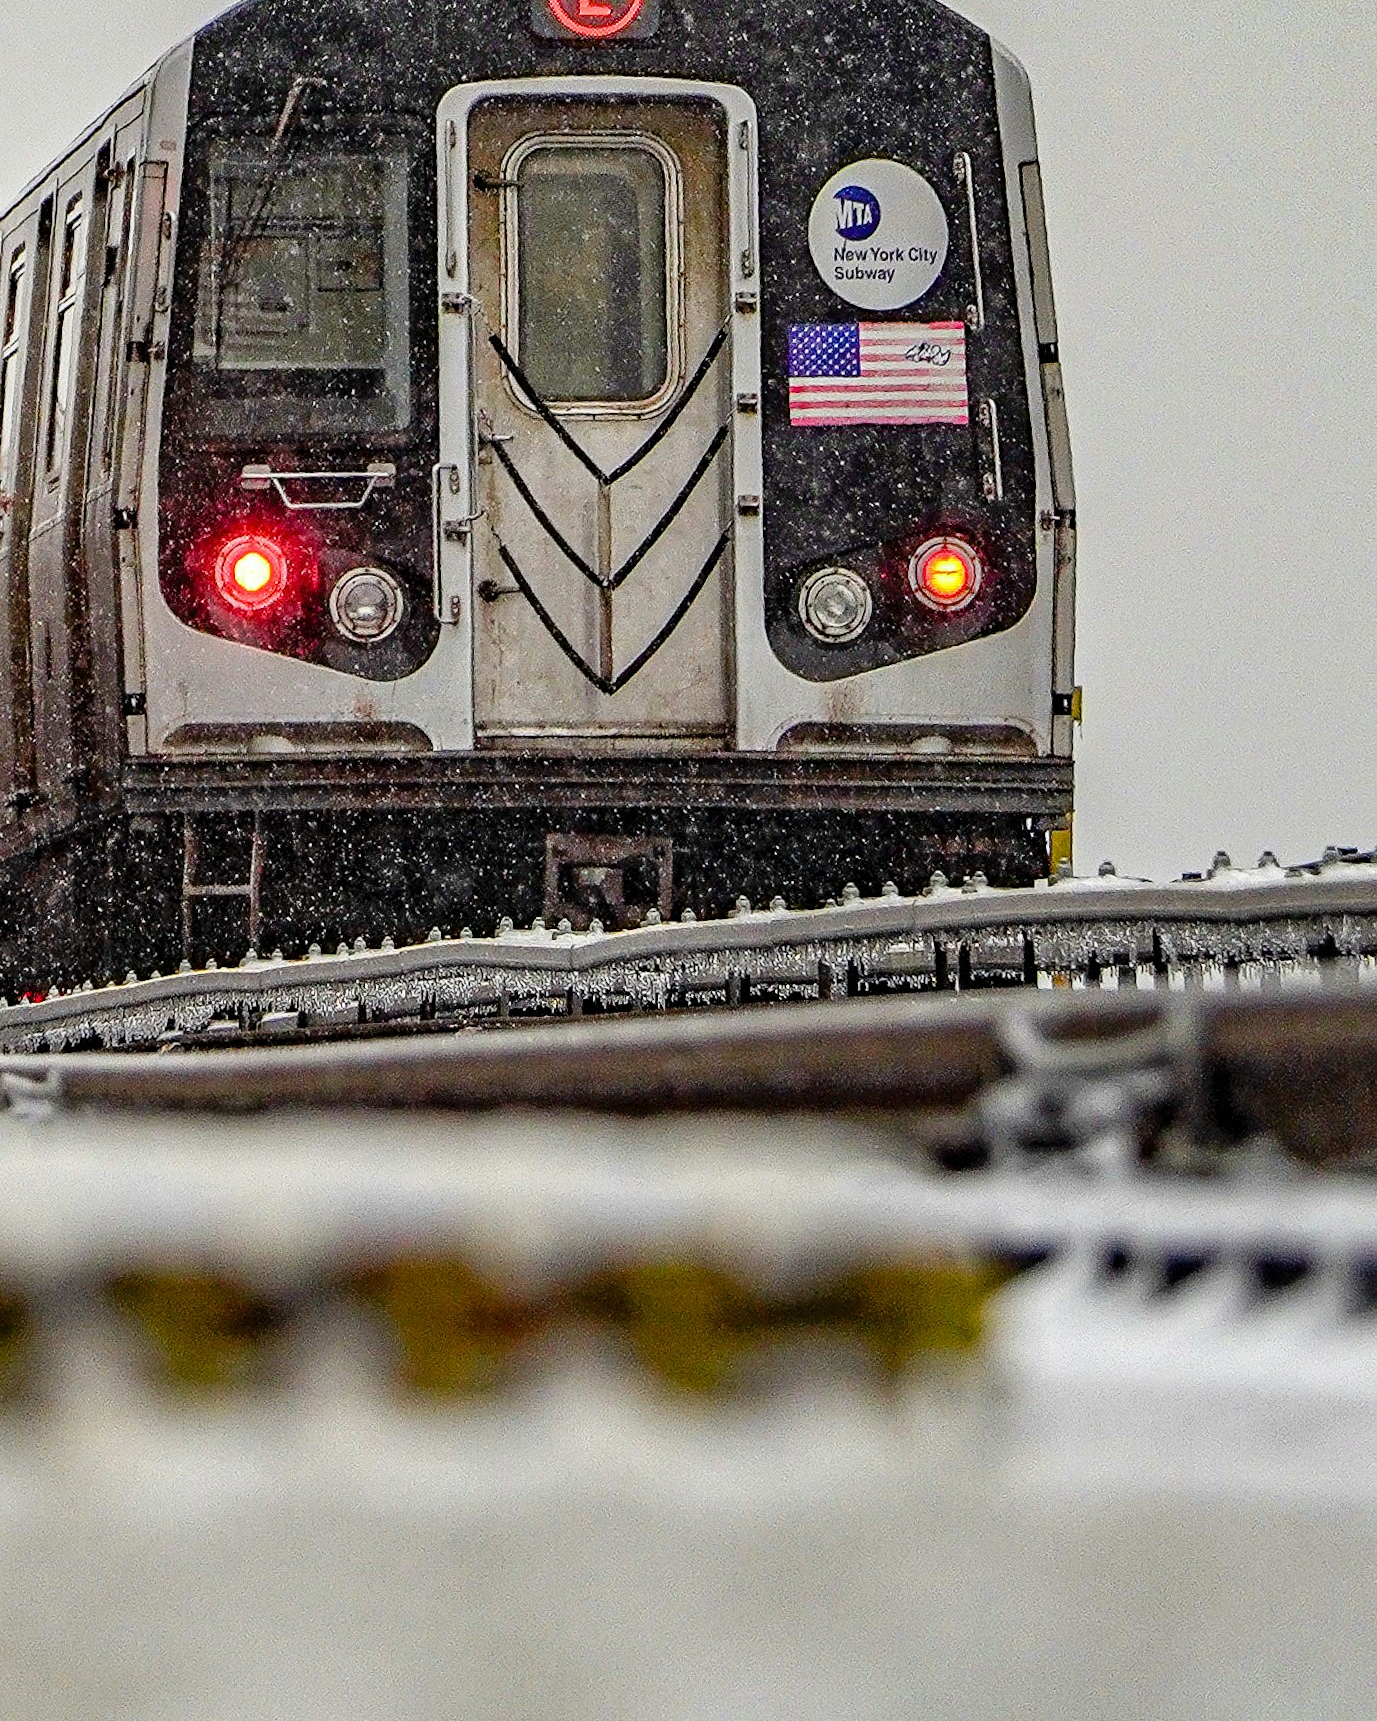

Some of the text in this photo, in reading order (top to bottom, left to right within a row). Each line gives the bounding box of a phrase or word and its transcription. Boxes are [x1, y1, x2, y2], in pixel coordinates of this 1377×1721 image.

[833, 197, 874, 231] MTA
[833, 247, 938, 265] New York City
[834, 266, 896, 284] Subway
